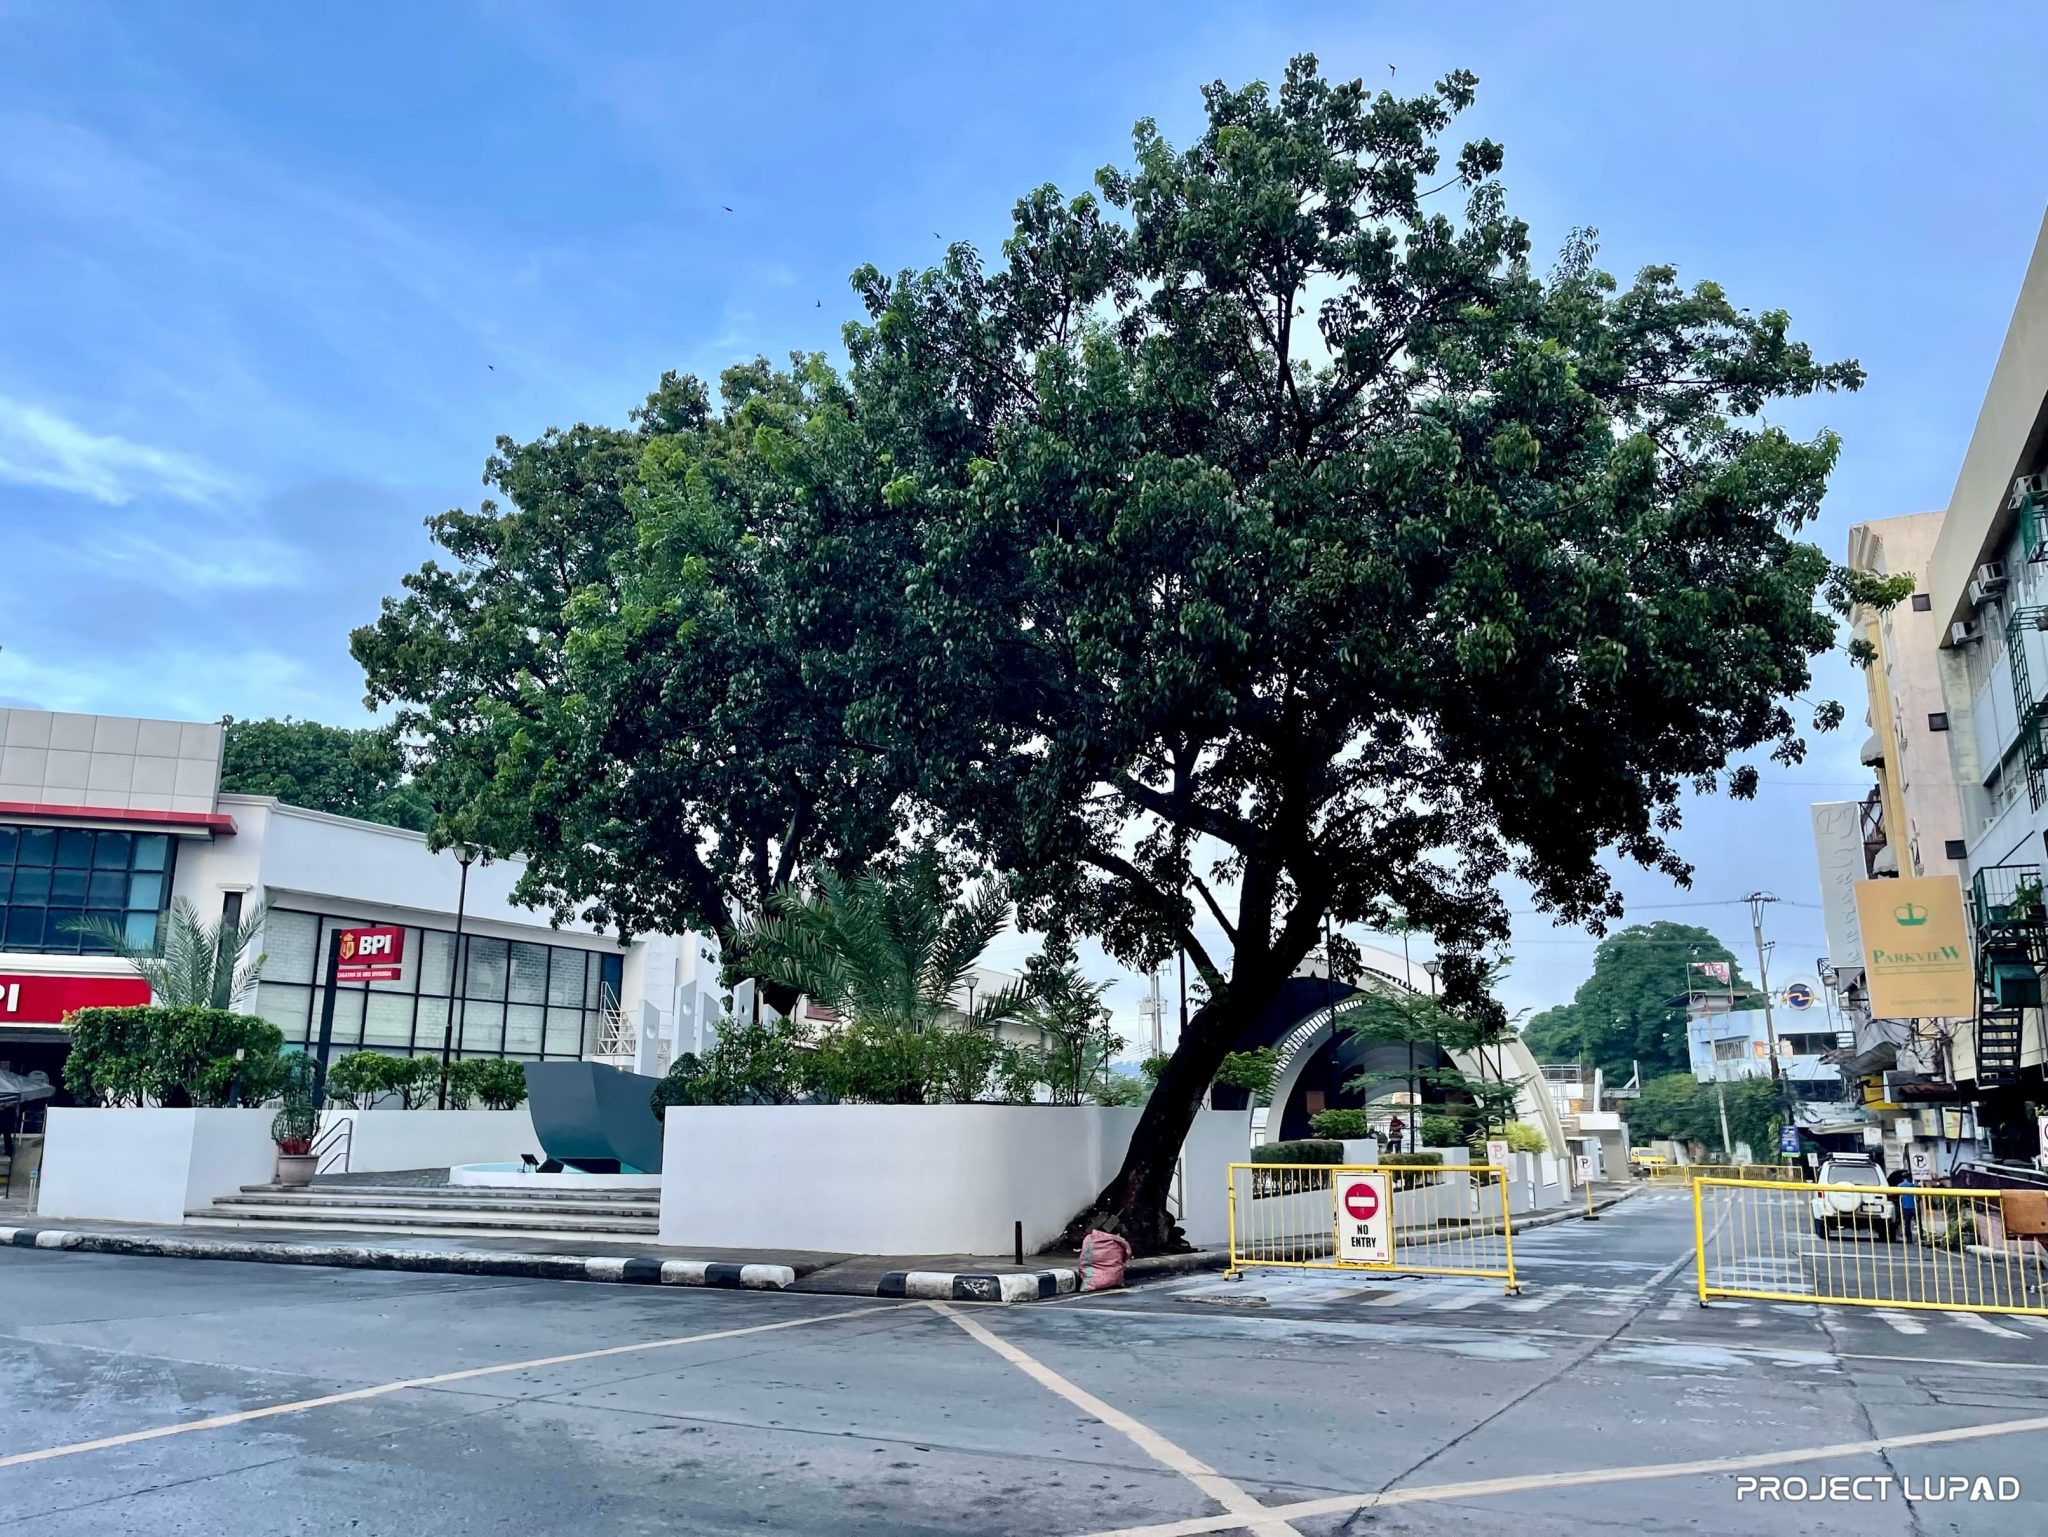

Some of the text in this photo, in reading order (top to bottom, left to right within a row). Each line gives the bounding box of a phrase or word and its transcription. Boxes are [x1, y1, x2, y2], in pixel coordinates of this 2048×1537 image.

[358, 934, 393, 955] BPI
[1356, 1224, 1369, 1235] NO
[1351, 1236, 1377, 1248] ENTRY
